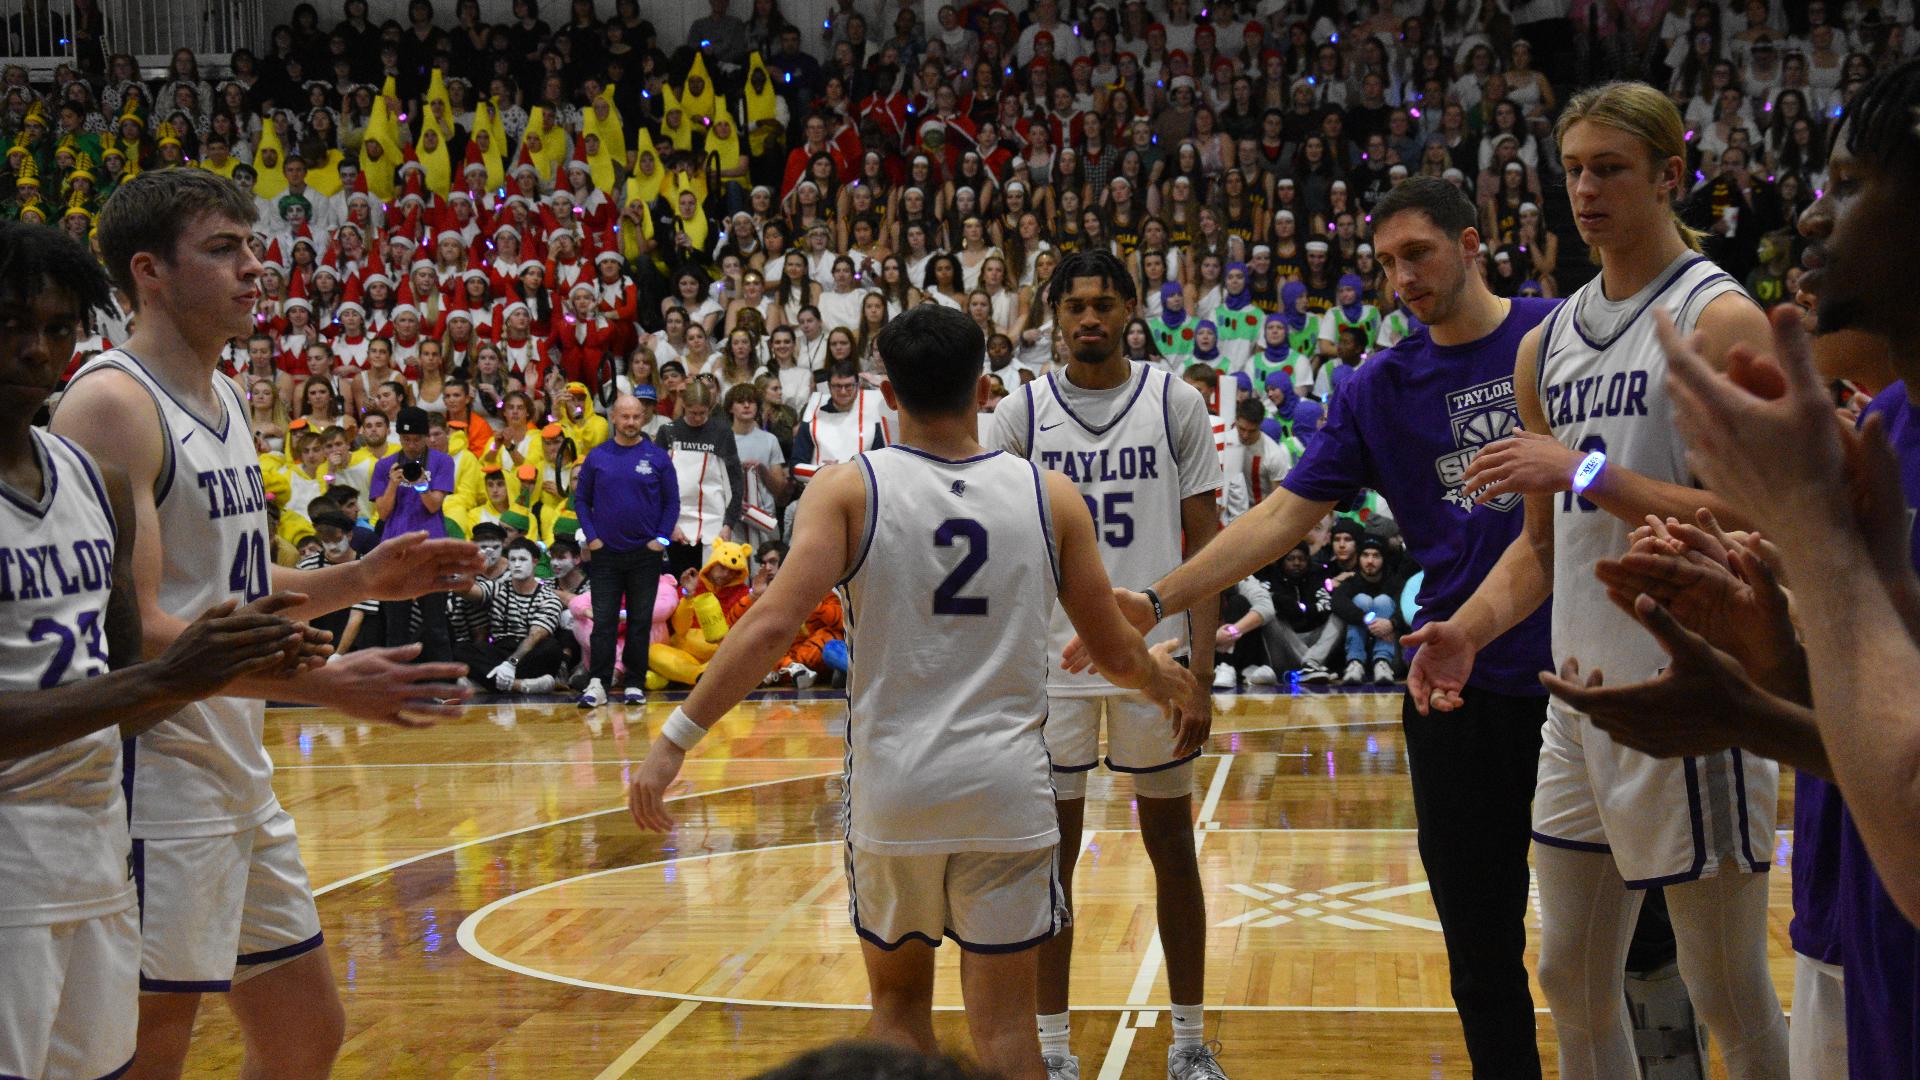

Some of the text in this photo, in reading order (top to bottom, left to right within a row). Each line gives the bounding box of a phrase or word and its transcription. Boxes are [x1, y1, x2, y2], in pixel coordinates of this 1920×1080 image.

[1453, 381, 1514, 409] TAYLOR
[1547, 371, 1648, 429] TAYLOR
[683, 442, 715, 452] TAYLOR
[1042, 446, 1158, 483] TAYLOR
[229, 529, 269, 604] 40
[933, 518, 988, 615] 2
